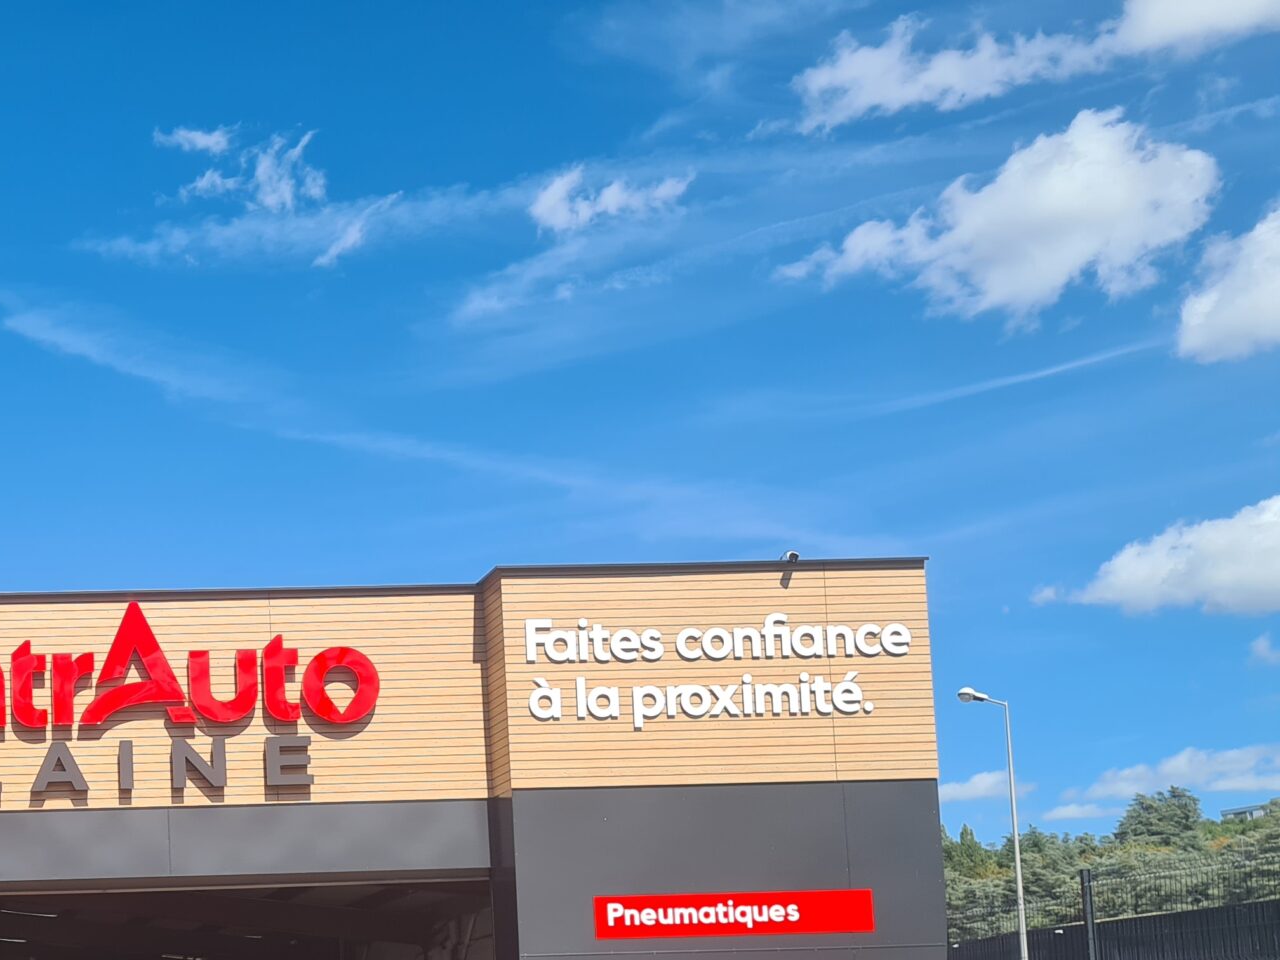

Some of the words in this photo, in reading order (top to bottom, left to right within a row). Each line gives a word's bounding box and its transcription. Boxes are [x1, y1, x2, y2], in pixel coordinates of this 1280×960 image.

[524, 617, 665, 663] Faites
[675, 612, 913, 661] confiance
[528, 677, 563, 720] à
[575, 676, 621, 719] la
[632, 671, 875, 730] proximité.
[606, 899, 801, 928] Pneumatiques
